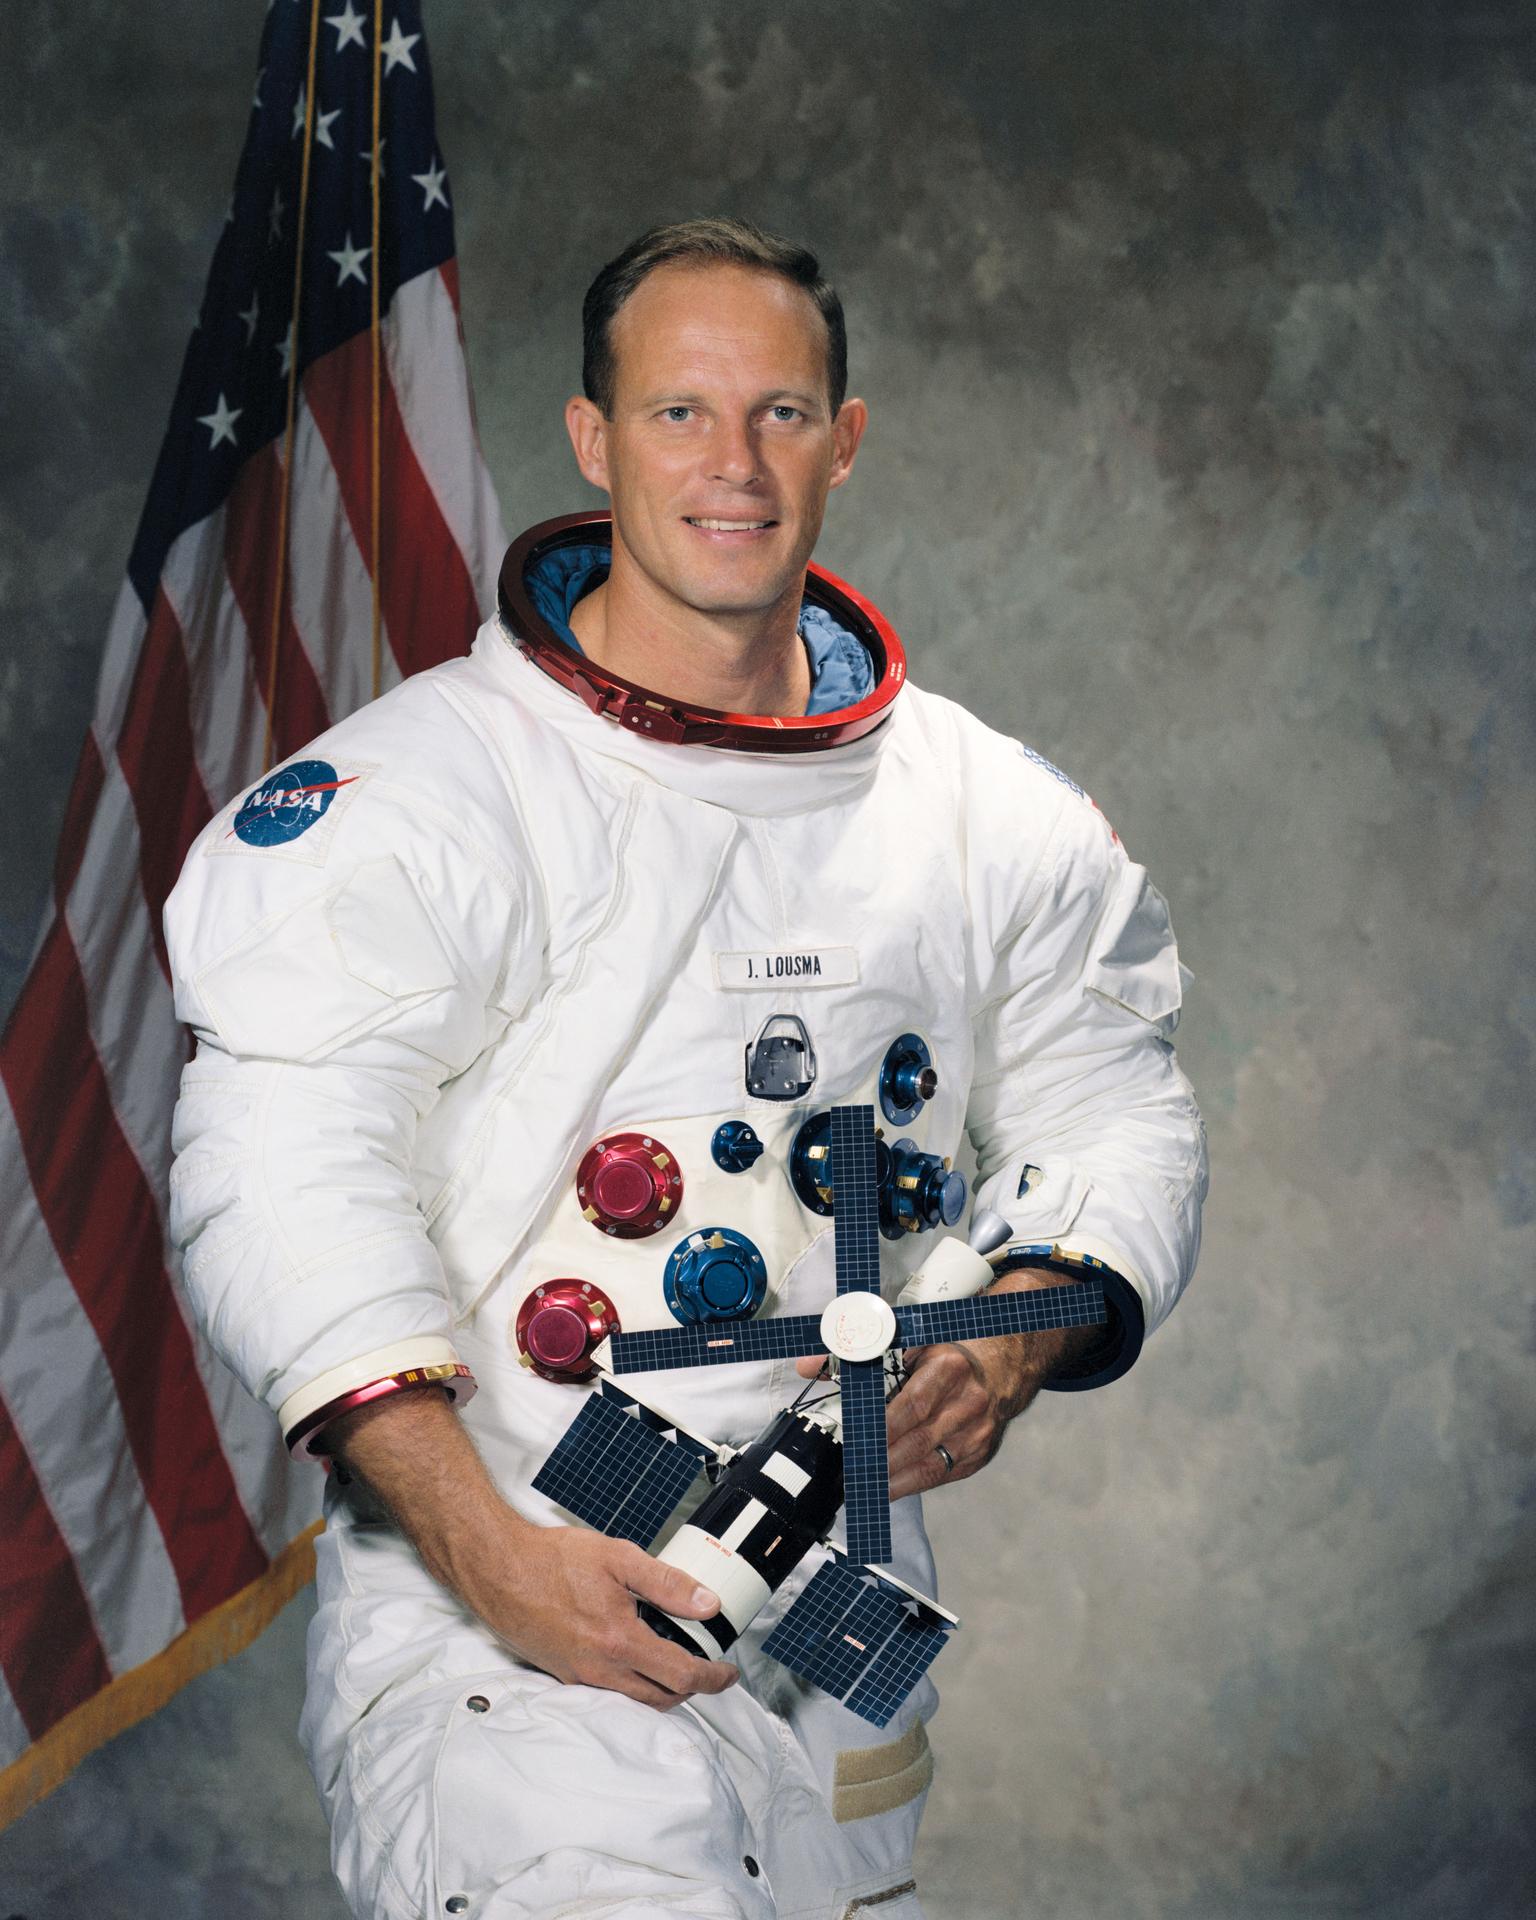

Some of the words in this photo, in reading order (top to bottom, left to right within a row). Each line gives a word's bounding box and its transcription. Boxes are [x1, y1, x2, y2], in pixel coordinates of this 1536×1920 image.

[246, 789, 323, 813] NASA
[747, 958, 759, 978] J.
[766, 955, 822, 978] LOUSMA
